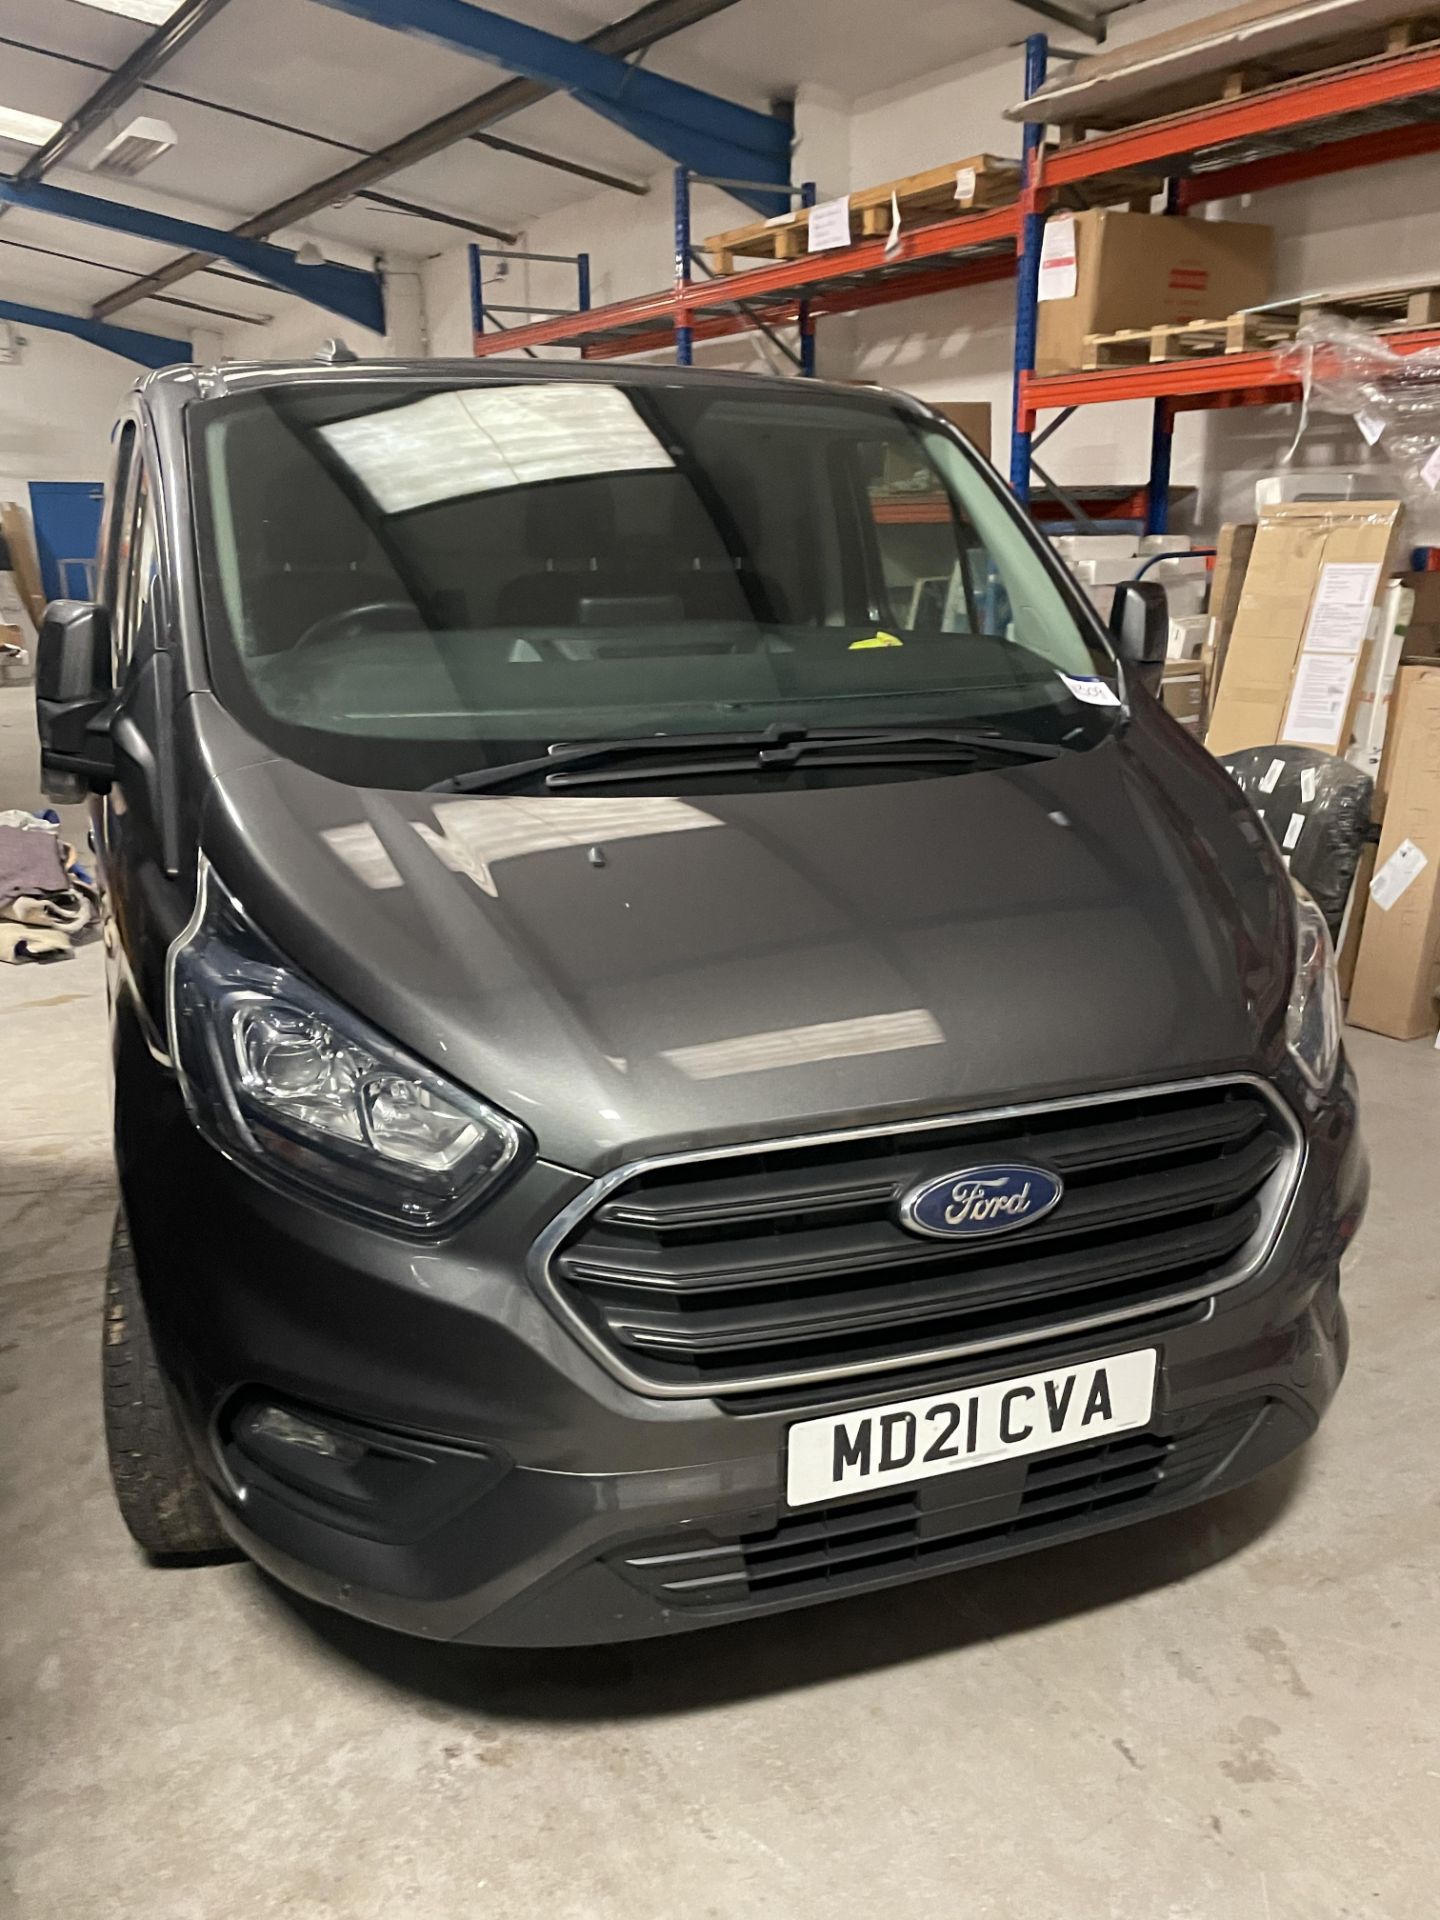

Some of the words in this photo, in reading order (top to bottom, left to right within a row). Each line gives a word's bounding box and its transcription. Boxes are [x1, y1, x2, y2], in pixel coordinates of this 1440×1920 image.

[944, 1177, 1031, 1225] Ford
[832, 1397, 979, 1482] MD21
[999, 1368, 1113, 1445] CVA
